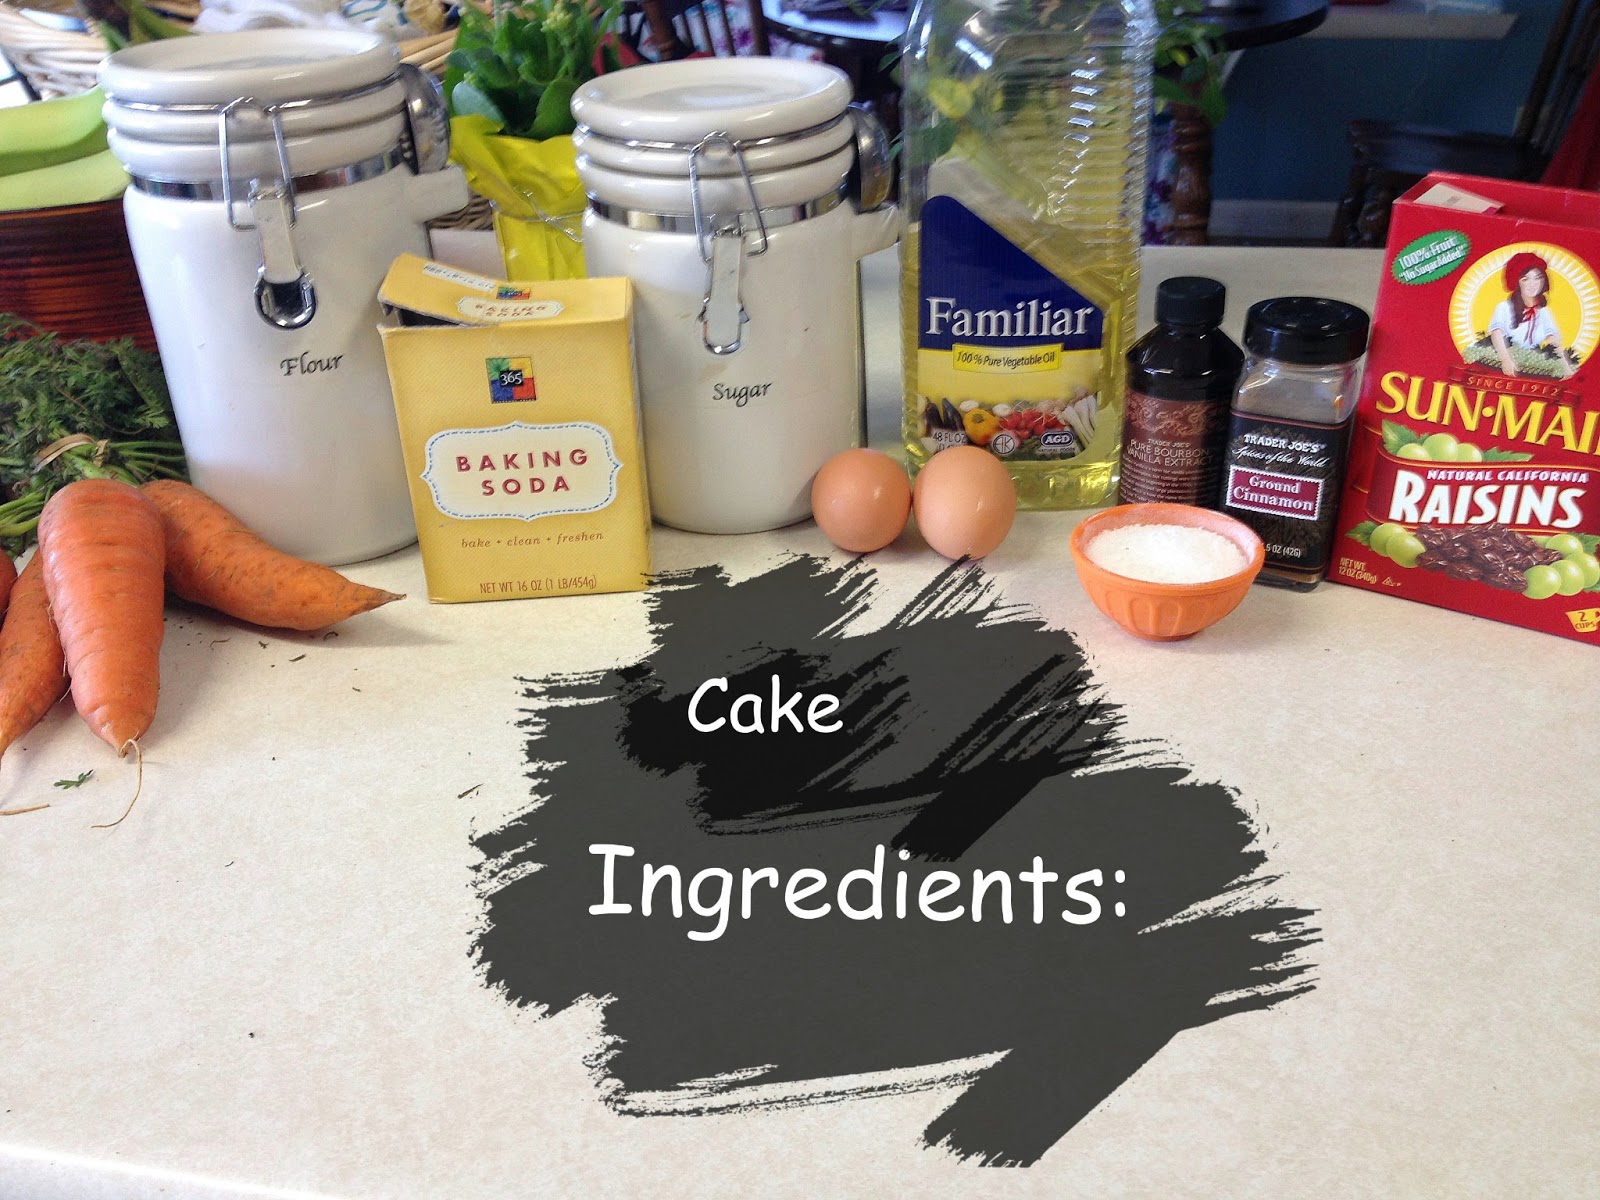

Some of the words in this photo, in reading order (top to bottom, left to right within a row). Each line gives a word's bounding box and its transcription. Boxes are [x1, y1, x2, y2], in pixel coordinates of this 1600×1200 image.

[1430, 235, 1458, 256] Fruit
[1415, 260, 1437, 274] Sugar
[925, 296, 1095, 337] Familiar
[280, 350, 345, 376] Flour
[983, 355, 1002, 367] Pure
[1002, 354, 1042, 370] Vegetable
[1042, 351, 1055, 364] Oil
[500, 371, 522, 386] 365
[1466, 375, 1512, 390] SINCE
[1521, 383, 1560, 397] 1912
[712, 381, 773, 408] Sugar
[933, 431, 943, 442] 48
[944, 432, 953, 443] FL
[954, 433, 966, 443] OZ
[1045, 435, 1070, 444] AGD
[1243, 434, 1286, 449] TRADER
[1127, 445, 1161, 465] VANILLA
[1164, 455, 1214, 467] EXTRACT
[1130, 439, 1152, 454] PURE
[1154, 447, 1209, 458] BOURBON
[1232, 445, 1265, 460] Spices
[1298, 454, 1331, 468] World
[455, 449, 588, 473] BAKING
[481, 475, 570, 497] SODA
[1249, 475, 1302, 494] Ground
[1427, 469, 1495, 481] NATURAL
[1497, 470, 1590, 484] CALIFORNIA
[1233, 486, 1314, 511] Cinnamon
[1388, 469, 1588, 529] RAISINS
[461, 536, 491, 548] bake
[507, 535, 541, 547] clean
[556, 531, 604, 545] freshen
[1272, 545, 1282, 554] OZ
[1282, 547, 1301, 558] (42G)
[1340, 557, 1354, 568] NET
[1339, 566, 1346, 575] 12
[1346, 569, 1356, 578] OZ
[1355, 570, 1377, 585] (340g)
[480, 582, 496, 594] NET
[499, 581, 513, 593] WT
[518, 580, 528, 592] 16
[530, 580, 542, 591] OZ
[1575, 621, 1596, 630] CUPS
[1578, 611, 1588, 622] 2
